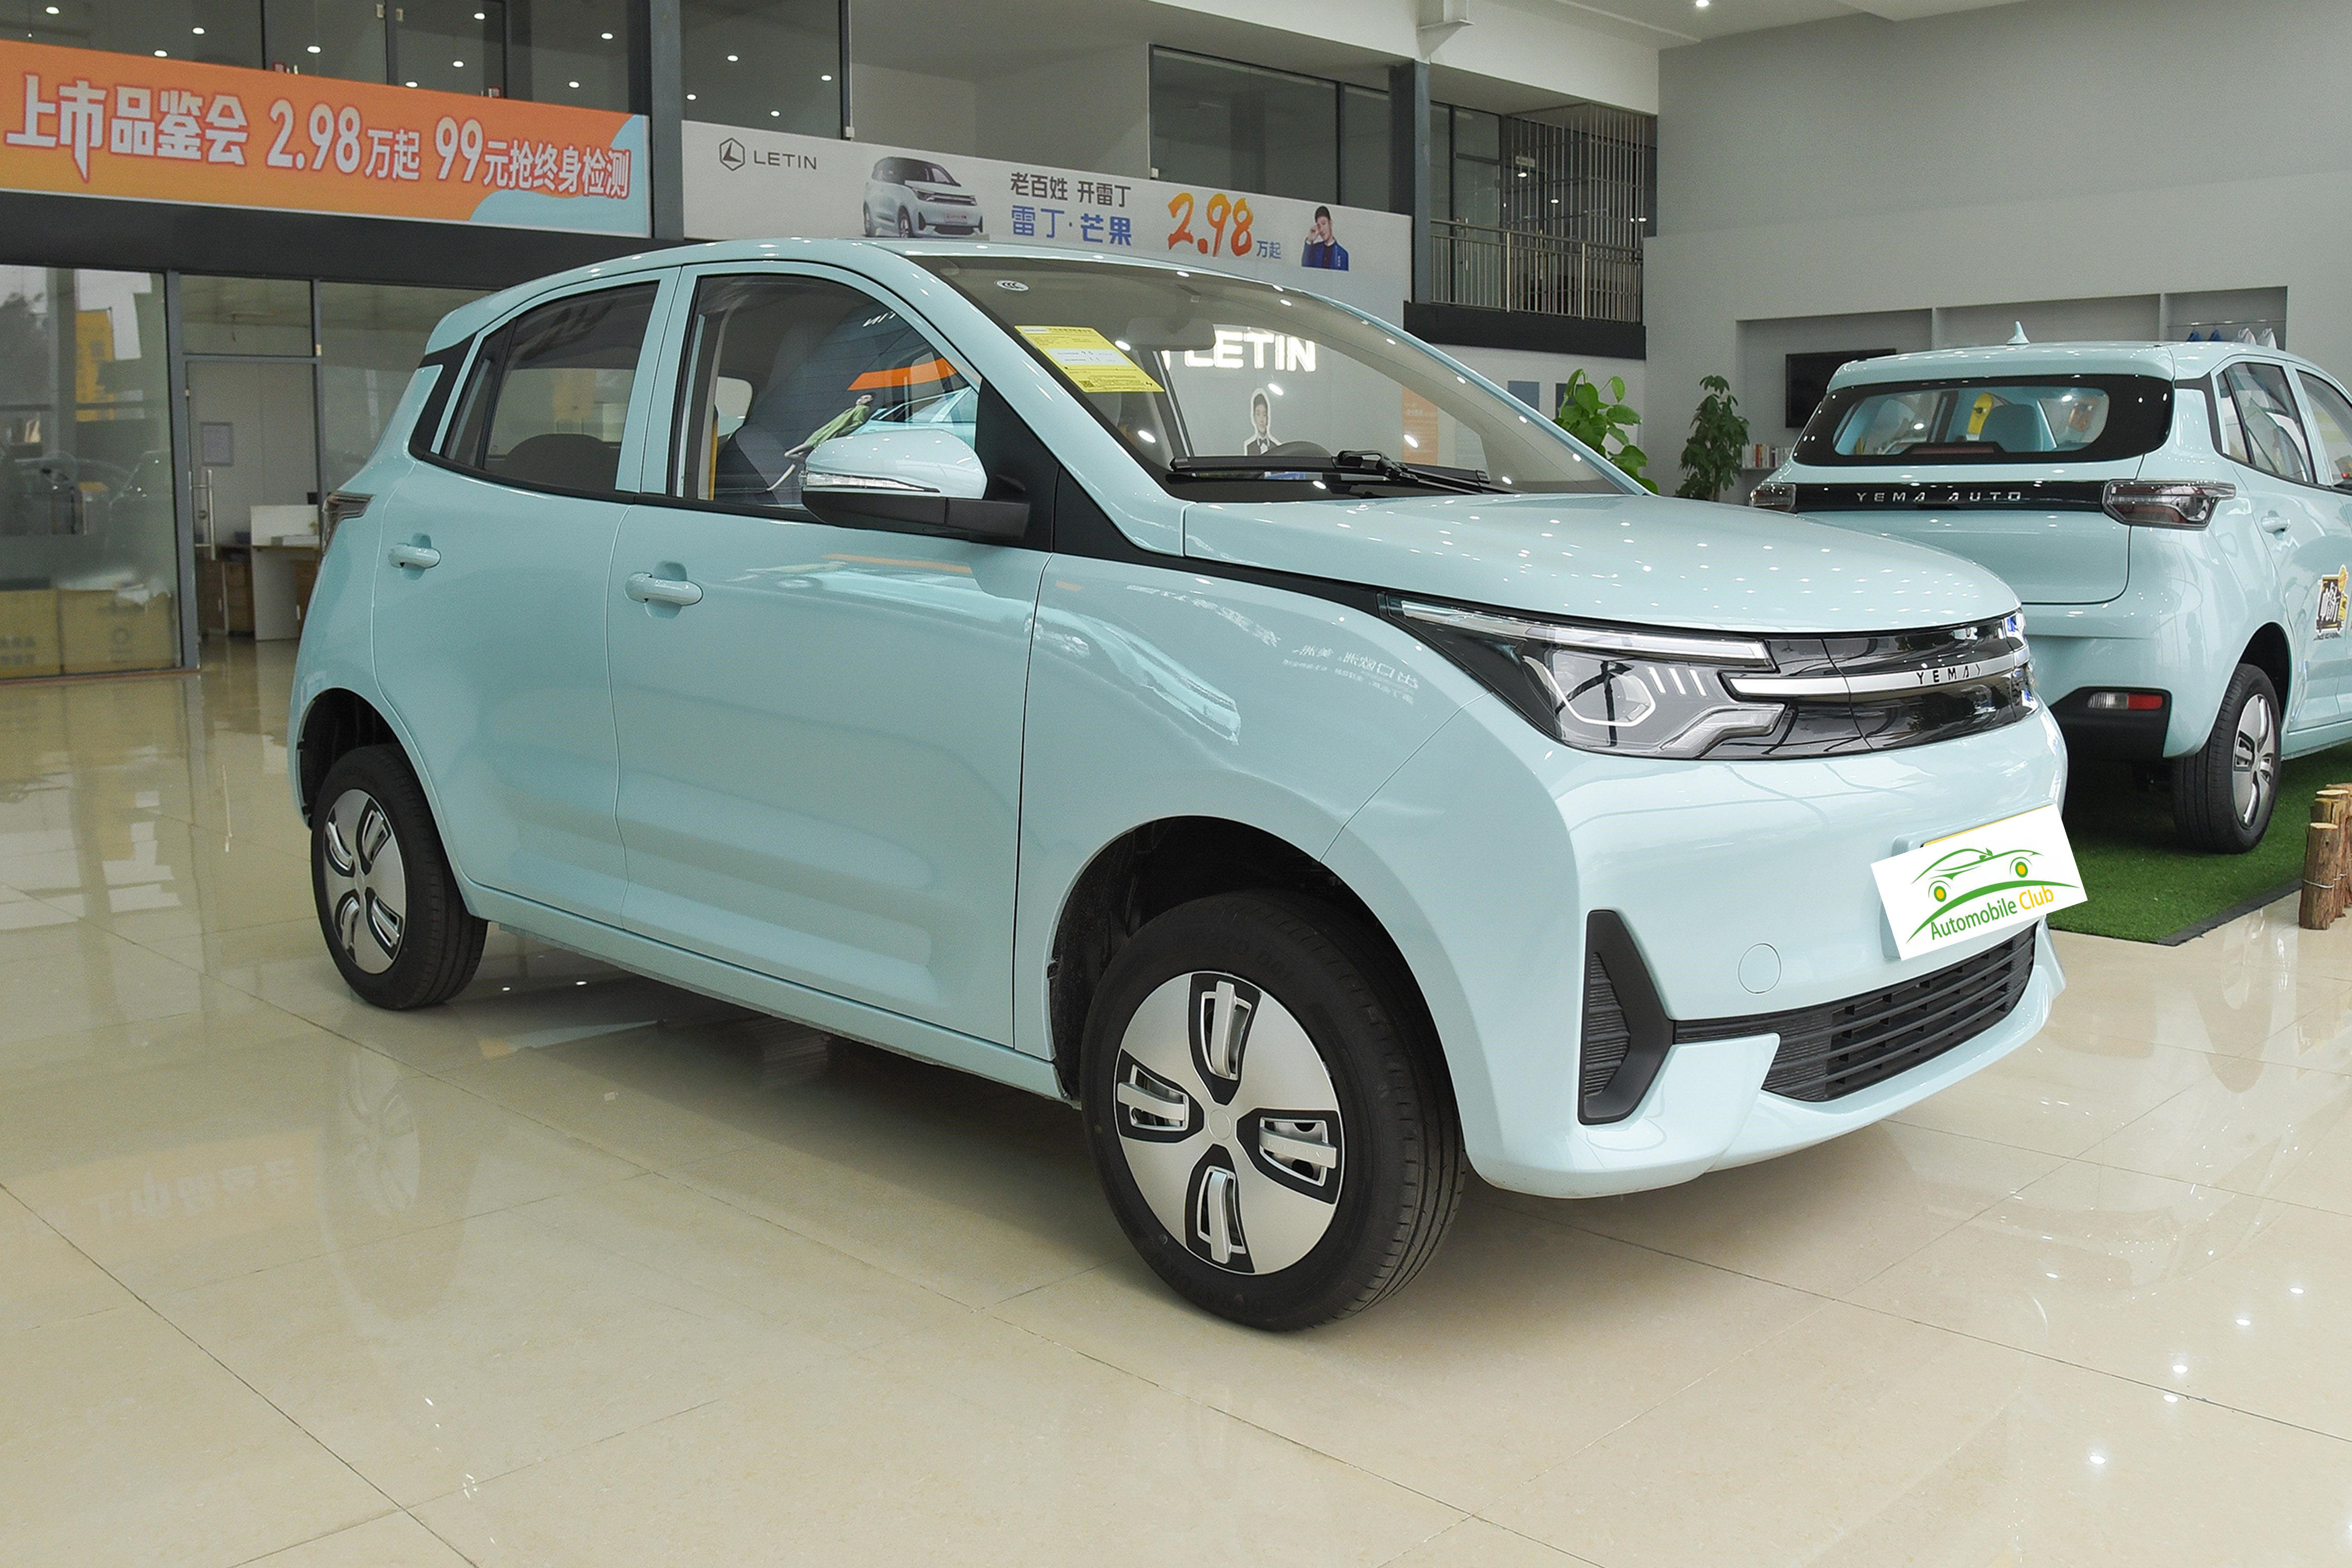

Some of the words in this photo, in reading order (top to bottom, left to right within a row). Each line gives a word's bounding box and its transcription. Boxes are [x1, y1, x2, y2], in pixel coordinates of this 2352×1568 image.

[5, 74, 248, 182] 上市品鉴会
[435, 116, 630, 198] 99元抢终身检测
[753, 150, 817, 170] LETIN
[1010, 172, 1068, 201] 老百姓
[1077, 180, 1131, 207] 开雷丁
[1856, 492, 1926, 502] YEMA
[1947, 492, 2022, 502] AUTO
[1916, 665, 1969, 684] YEMA
